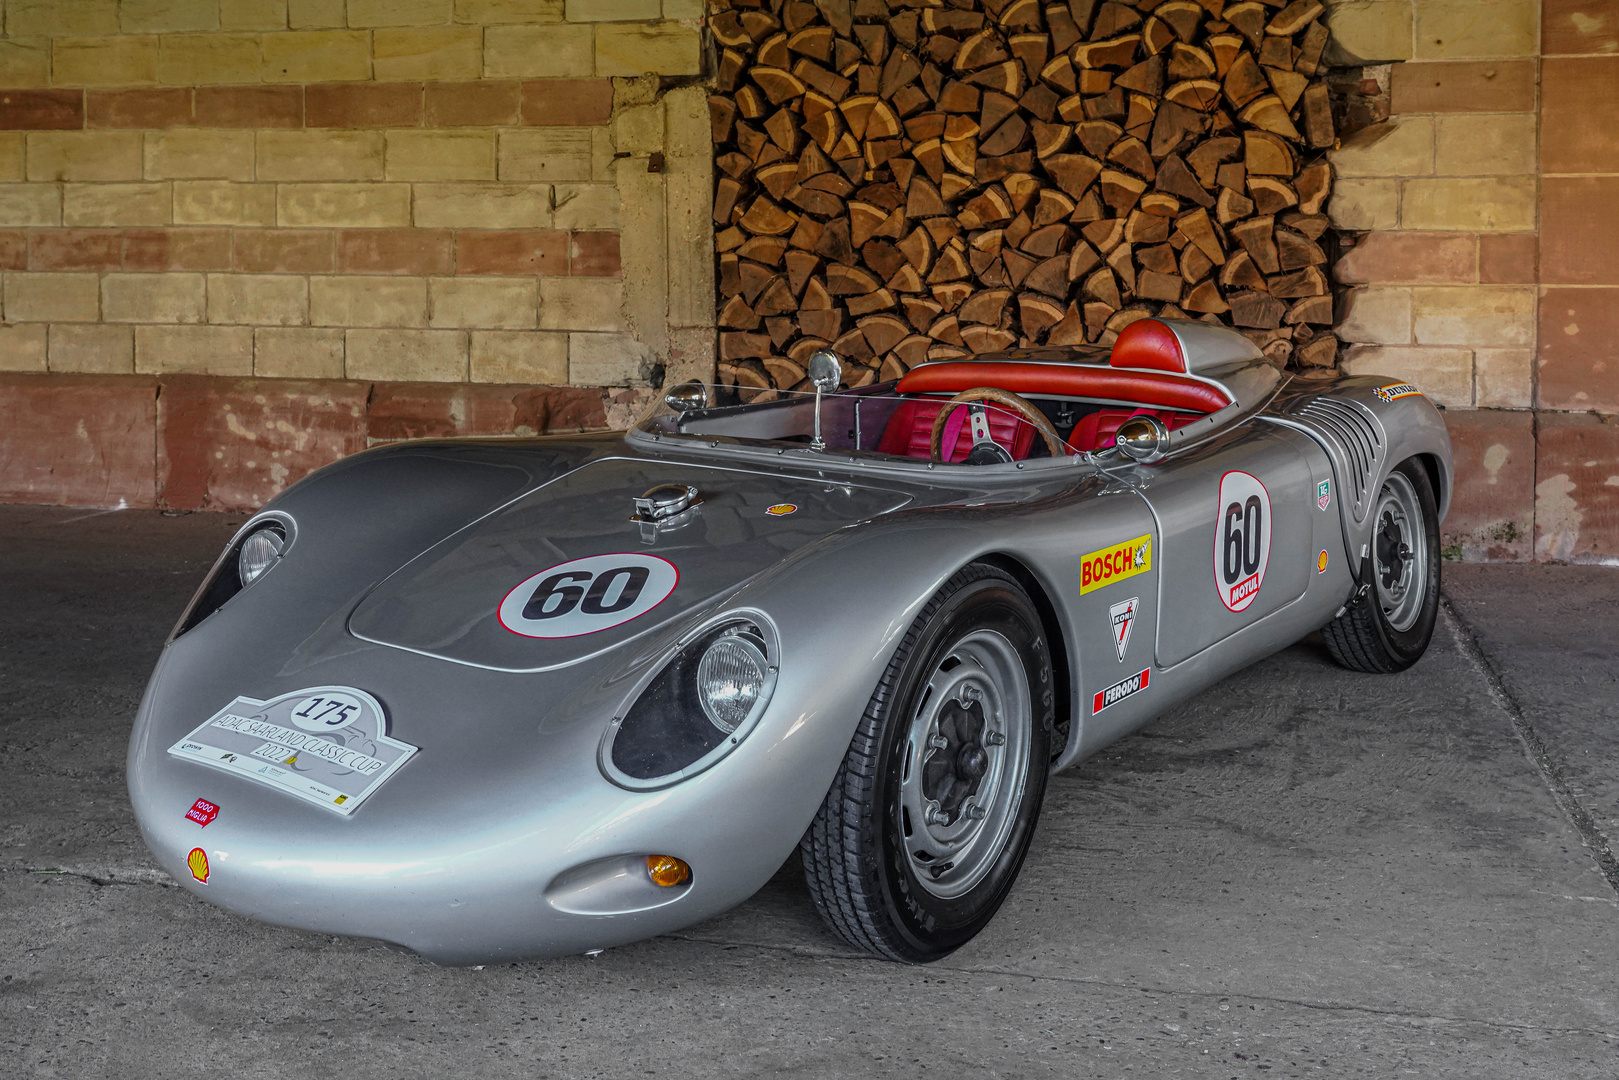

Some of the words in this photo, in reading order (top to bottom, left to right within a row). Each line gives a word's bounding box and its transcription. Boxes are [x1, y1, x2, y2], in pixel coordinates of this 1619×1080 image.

[1223, 494, 1262, 585] 60
[1082, 546, 1133, 587] BOSCH
[521, 566, 650, 620] 60
[1231, 576, 1258, 604] MOTUL
[1114, 611, 1132, 625] KONI
[1105, 676, 1140, 706] FERODO
[295, 697, 358, 726] 175
[214, 715, 250, 730] ADAC
[243, 721, 306, 746] SAARLAND
[302, 738, 356, 763] CLASSIC
[349, 755, 382, 772] CUP
[255, 743, 291, 761] 2022
[187, 809, 208, 823] MIGLIA
[196, 800, 214, 813] 1000
